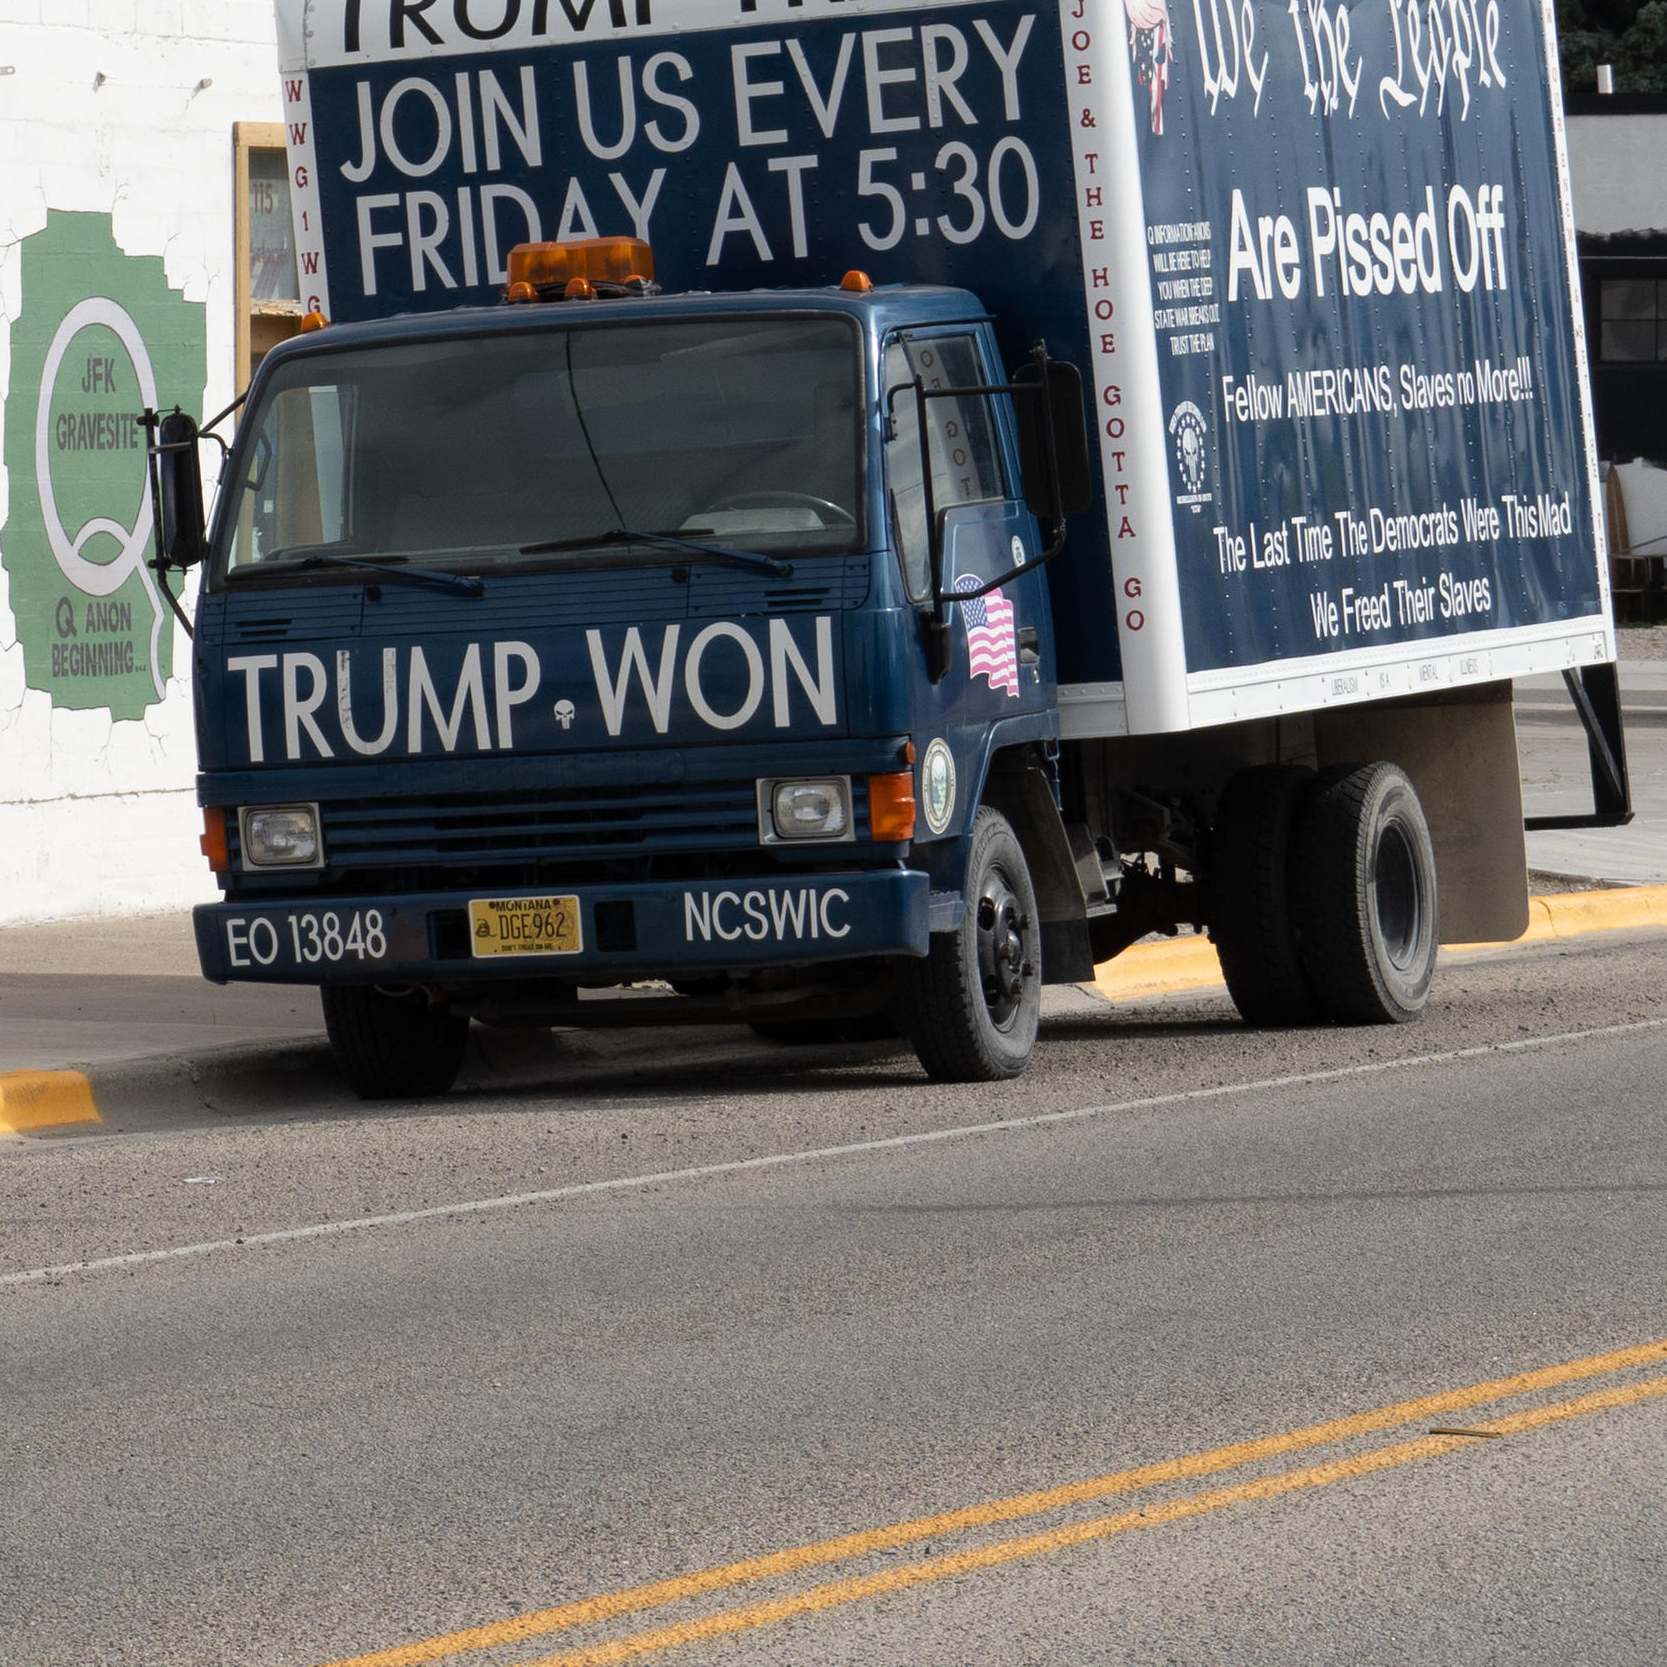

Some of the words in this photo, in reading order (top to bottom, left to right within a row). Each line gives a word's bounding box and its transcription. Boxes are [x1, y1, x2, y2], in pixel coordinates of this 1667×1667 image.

[340, 66, 542, 182] JOIN
[573, 52, 700, 159] US
[731, 14, 1036, 146] EVERY
[356, 169, 666, 296] FRIDAY
[707, 155, 818, 266] AT
[858, 136, 1039, 250] 5:30
[1227, 188, 1302, 302] Are
[1306, 184, 1444, 298] Pissed
[1446, 182, 1508, 293] Off
[82, 357, 116, 394] JFK
[1221, 373, 1283, 423] Fellow
[1287, 364, 1398, 418] AMERICANS,
[1399, 363, 1456, 411] Slaves
[1456, 371, 1475, 405] no
[1474, 356, 1534, 404] More!!!
[56, 412, 139, 451] GRAVESITE
[1212, 526, 1247, 574] The
[1249, 520, 1291, 569] Last
[1290, 515, 1333, 563] Time
[1334, 510, 1369, 558] The
[1369, 502, 1459, 554] Democrats
[1460, 497, 1500, 543] Were
[1501, 494, 1539, 539] This
[1536, 490, 1573, 539] Mad
[56, 597, 77, 639] Q
[86, 602, 132, 634] ANON
[1309, 591, 1339, 639] We
[1341, 582, 1392, 635] Freed
[1392, 579, 1436, 626] Their
[1438, 571, 1492, 619] Slaves
[227, 641, 541, 762] TRUMP
[586, 616, 837, 736] WON
[496, 899, 551, 912] MONTANA
[499, 912, 566, 940] DGE962
[684, 888, 851, 941] NCSWIC
[226, 917, 278, 966] EO
[288, 909, 386, 962] 13848
